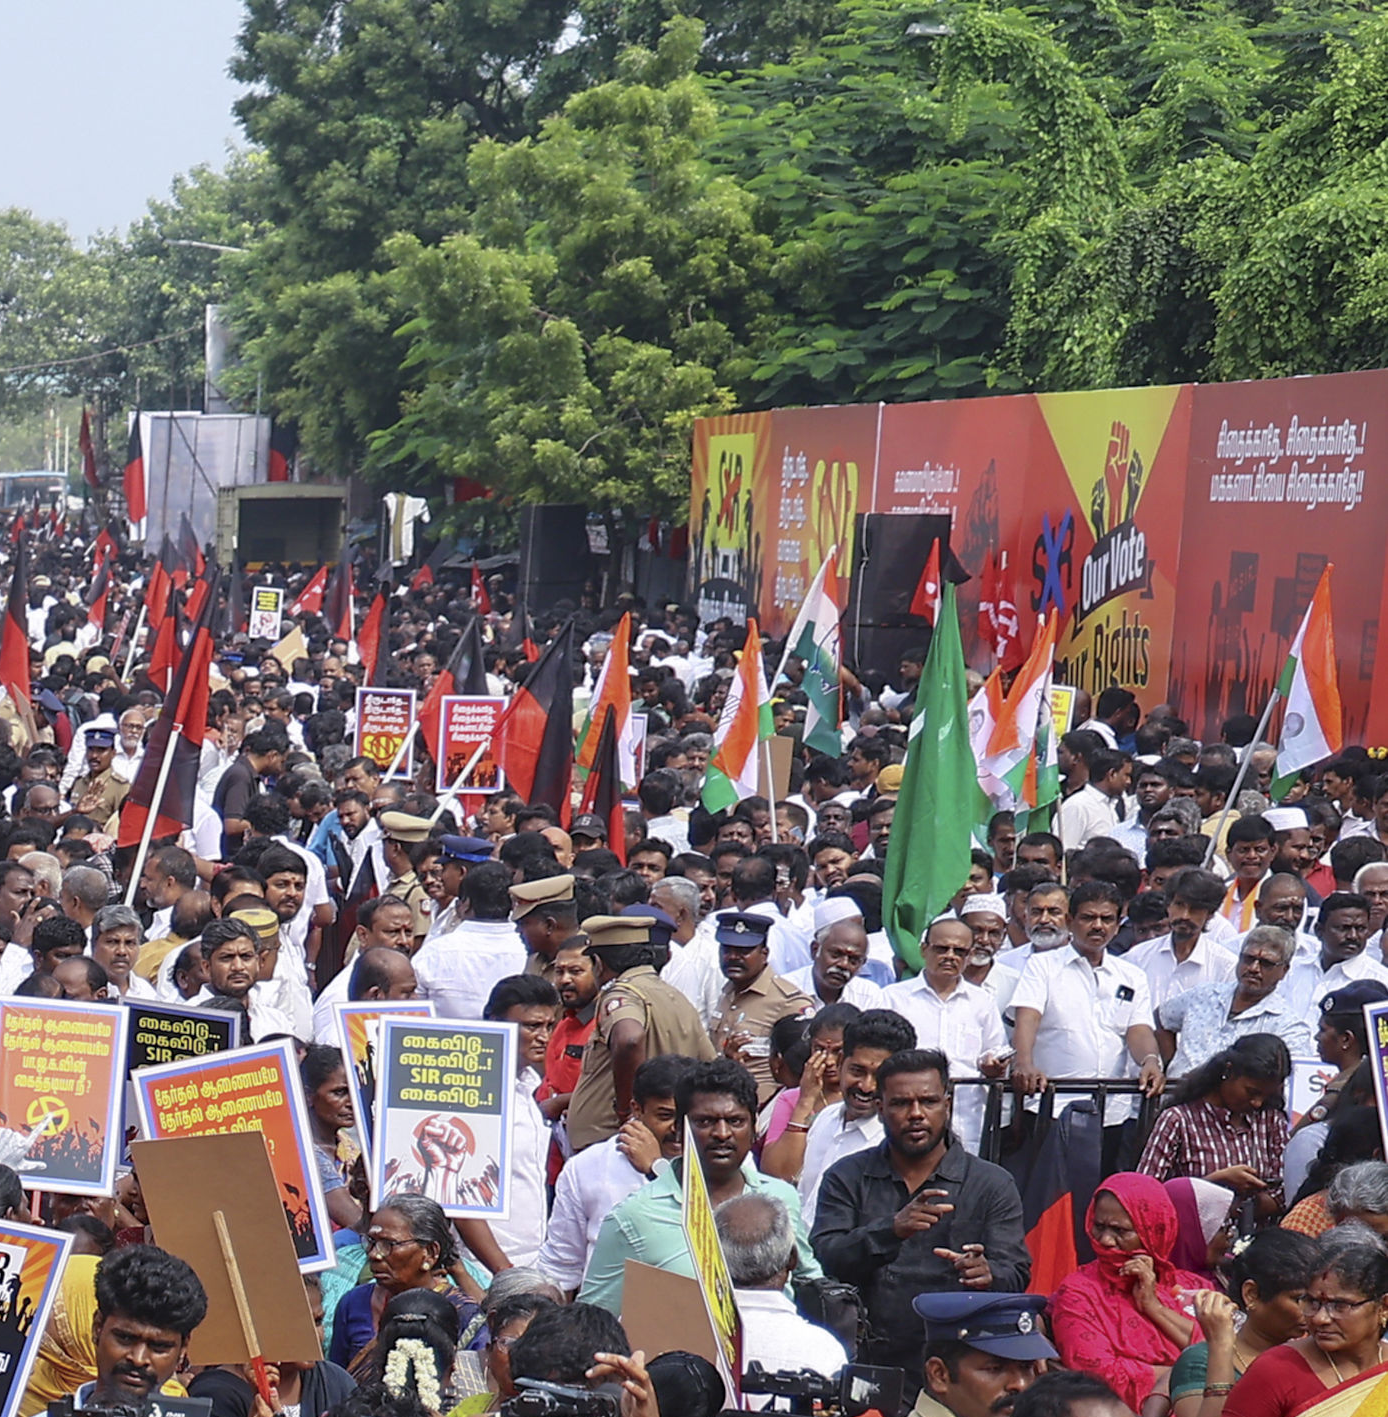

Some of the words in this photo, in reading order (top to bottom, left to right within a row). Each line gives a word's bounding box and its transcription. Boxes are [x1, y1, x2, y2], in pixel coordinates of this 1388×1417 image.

[1082, 551, 1110, 612] Our
[1110, 526, 1145, 591] Vote
[1092, 611, 1150, 695] Rights
[146, 1047, 172, 1062] SIR
[410, 1068, 439, 1084] SIR
[154, 1080, 199, 1110] தேர்தல்
[201, 1066, 278, 1099] ஆணையமே
[159, 1104, 204, 1133] தேர்தல்
[205, 1090, 283, 1122] ஆணையமே
